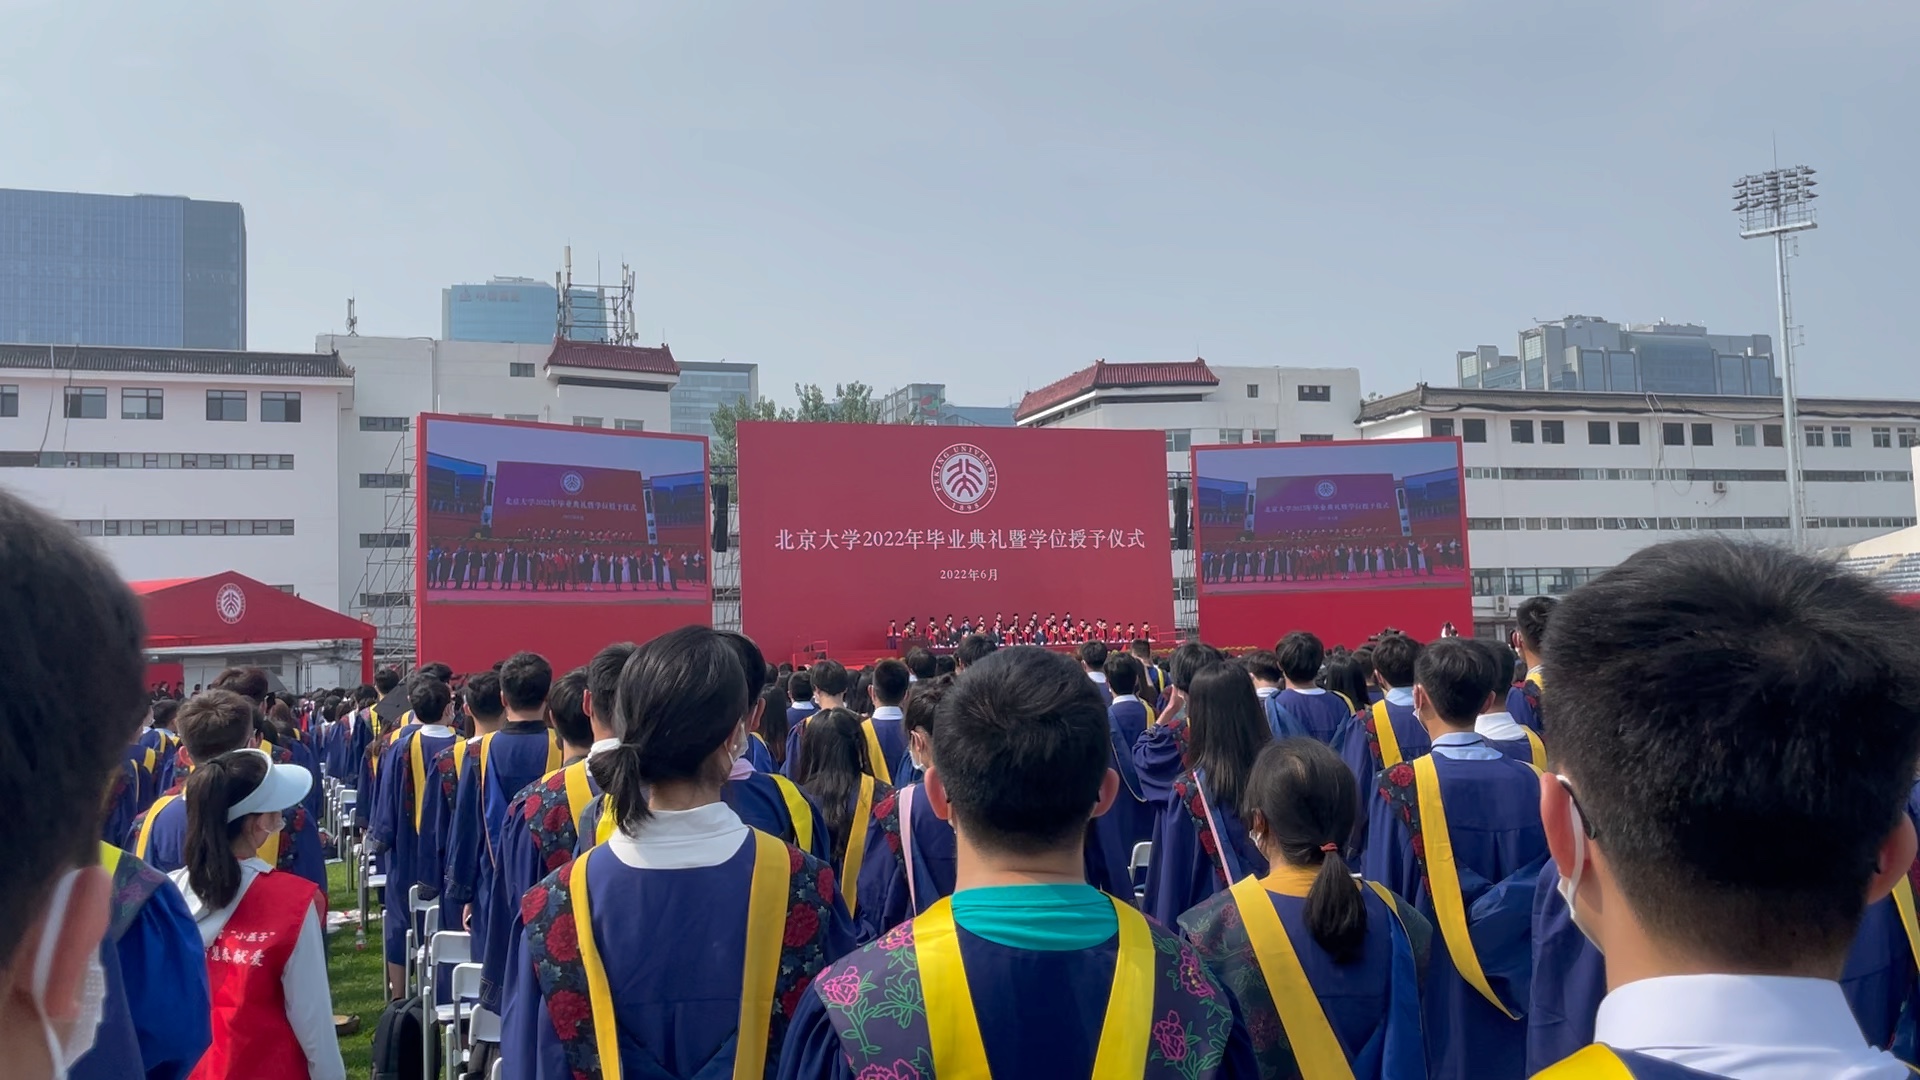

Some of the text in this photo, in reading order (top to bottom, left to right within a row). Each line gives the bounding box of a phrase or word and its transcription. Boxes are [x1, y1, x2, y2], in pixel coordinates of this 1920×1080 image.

[934, 446, 995, 493] PEKING UNIVERSITY
[952, 502, 980, 511] 1898
[775, 528, 1146, 551] 北京大学2022年毕业典礼暨学位授予仪式
[940, 568, 998, 582] 2022年6月
